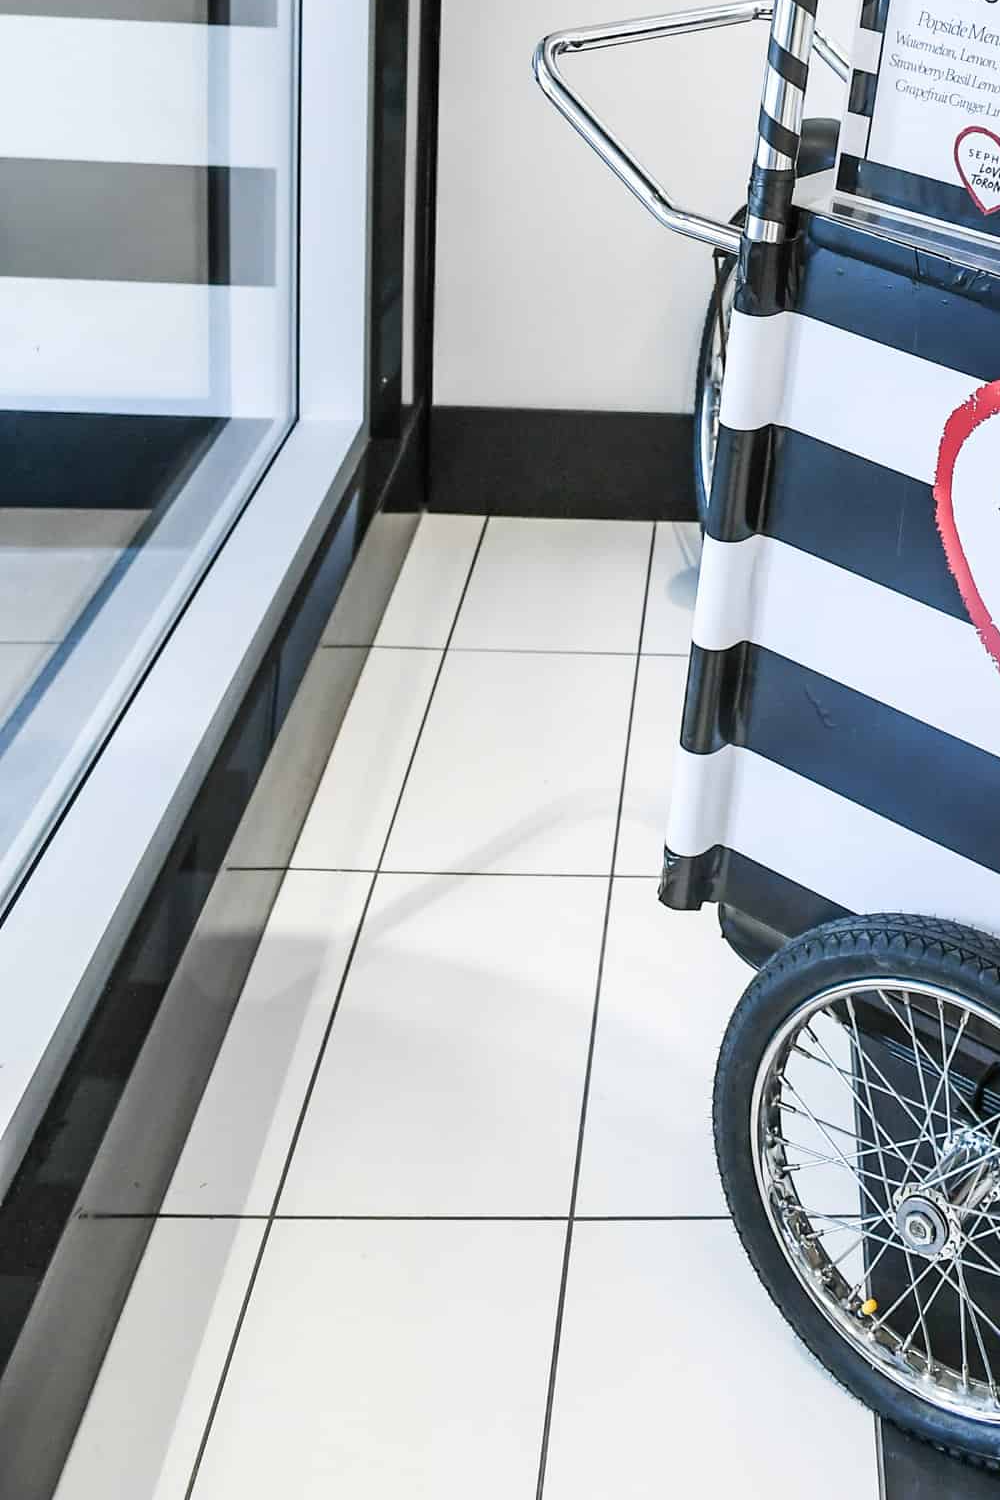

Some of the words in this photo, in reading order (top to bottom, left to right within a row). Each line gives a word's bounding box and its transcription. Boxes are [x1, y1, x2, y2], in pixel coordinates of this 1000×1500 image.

[888, 53, 945, 82] Strawberry
[944, 68, 971, 88] Basil
[895, 79, 949, 103] Grapefruit
[949, 93, 987, 115] Ginger
